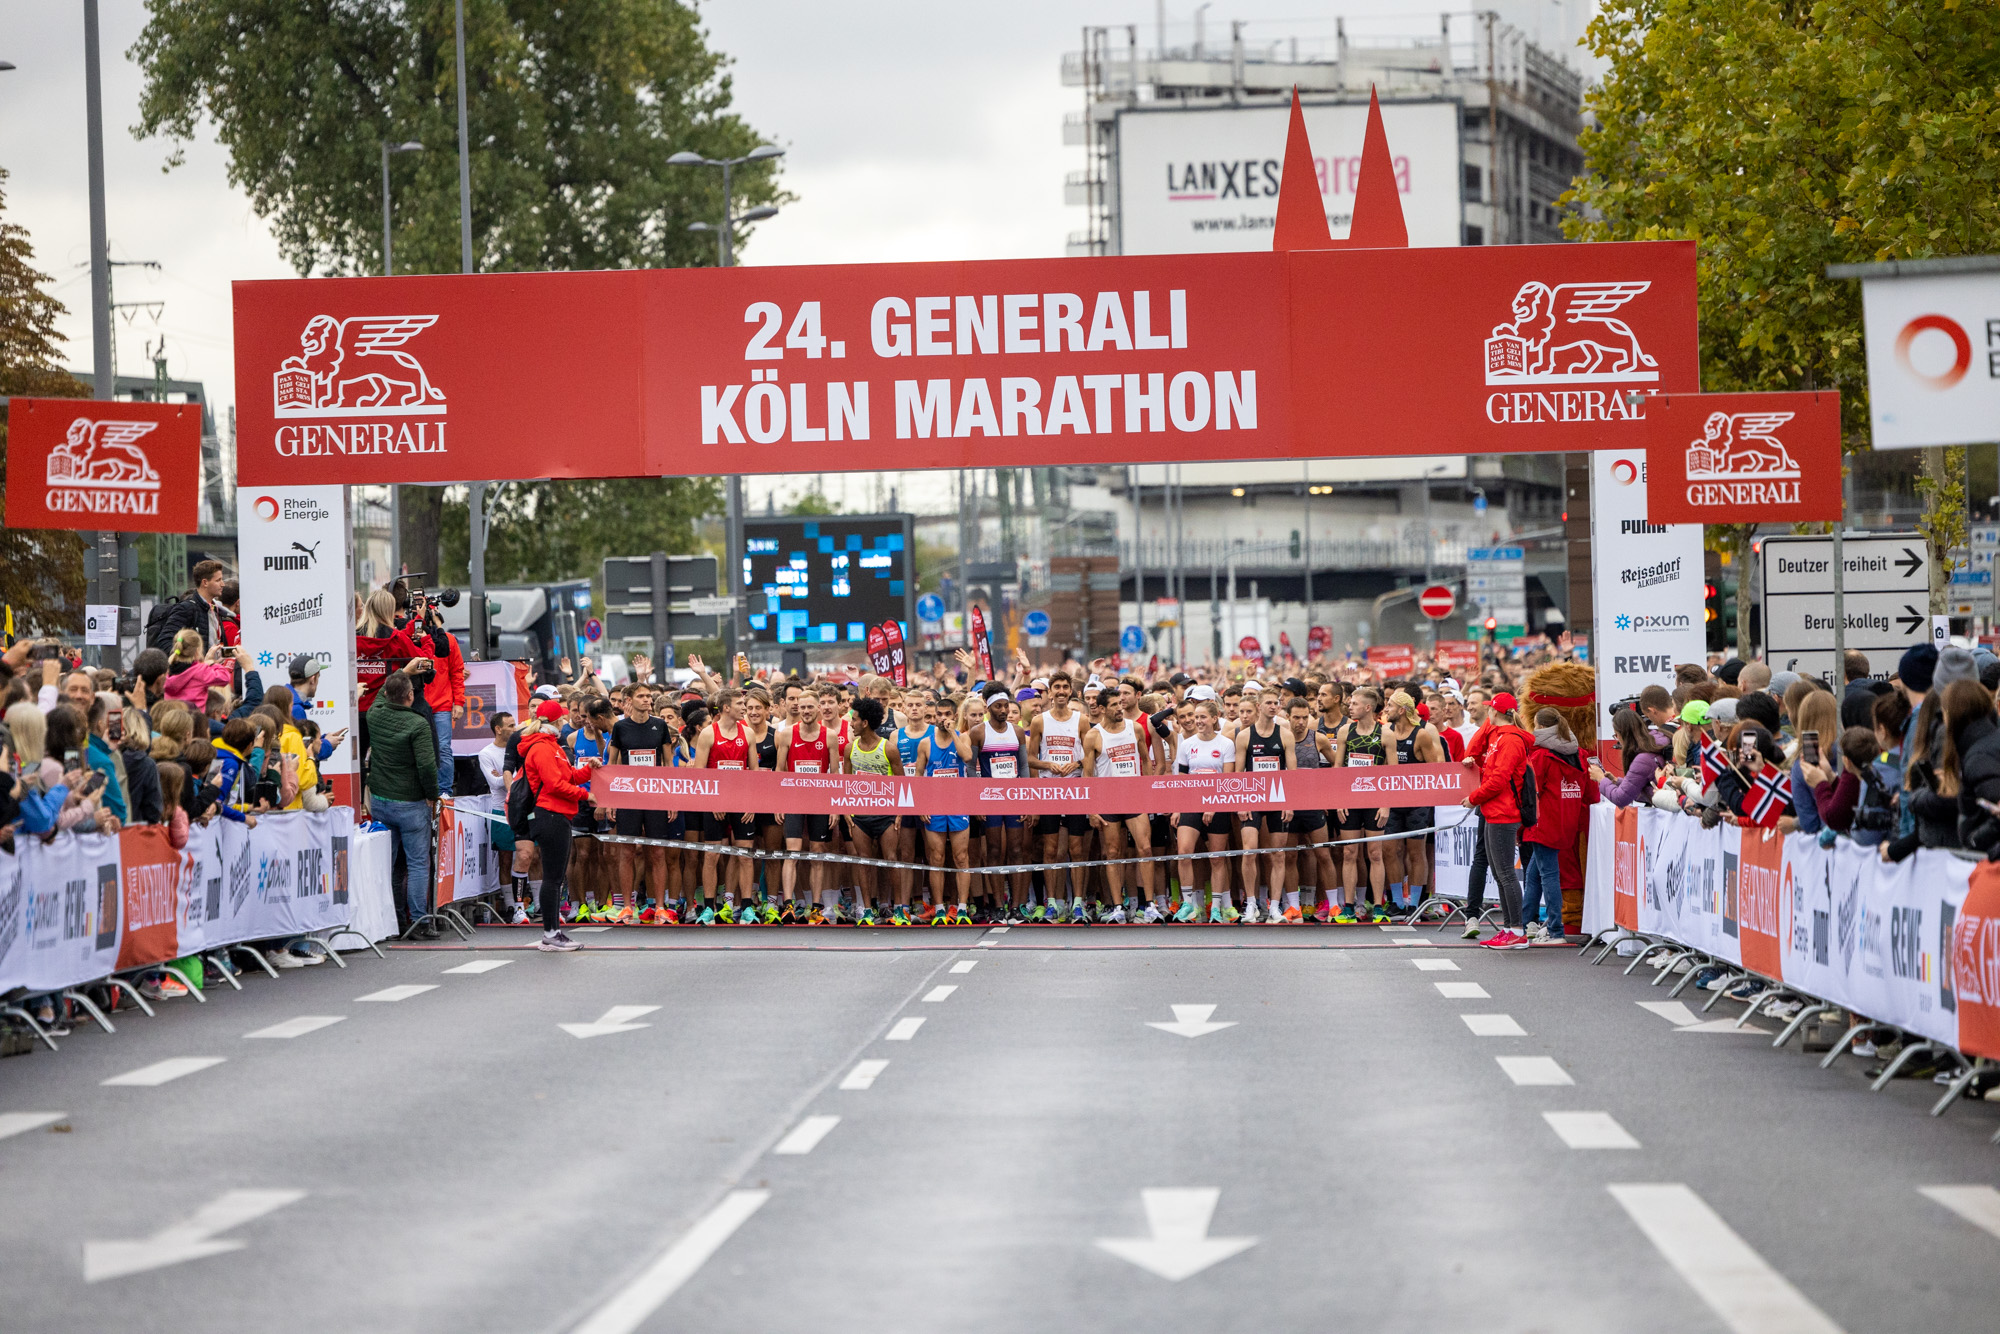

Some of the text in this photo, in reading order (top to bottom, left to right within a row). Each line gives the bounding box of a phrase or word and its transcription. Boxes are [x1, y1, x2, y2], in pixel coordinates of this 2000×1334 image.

[1167, 154, 1411, 199] LANXES area
[743, 288, 1188, 361] 24. GENERALI
[700, 368, 1258, 445] KÖLN MARATHON
[1486, 389, 1659, 424] GENERAL
[274, 422, 448, 457] GENERALI
[45, 488, 161, 515] GENERALI
[283, 498, 317, 508] Rhein
[1686, 480, 1801, 507] GENERALI
[284, 508, 329, 521] Energie
[264, 555, 309, 571] PUMA
[1620, 556, 1681, 584] Reissdorf
[1778, 555, 1888, 574] Deutzer reiheit
[1637, 571, 1680, 589] ALKOHOLFREI
[263, 593, 324, 621] Reissdorf
[279, 608, 323, 626] ALKOHOLFREI
[1633, 615, 1689, 633] pixum
[1805, 613, 1889, 632] Beruskolleg
[874, 654, 890, 675] 1:30
[891, 648, 903, 667] 30
[1614, 655, 1672, 673] REWE
[1352, 759, 1369, 767] 10004
[635, 777, 720, 796] GENERALI
[795, 778, 843, 789] GENERALI
[1166, 779, 1215, 789] GENERALI
[1377, 773, 1462, 792] GENERALI
[831, 797, 895, 807] MARATHON
[1006, 786, 1090, 801] GENERALI
[1202, 793, 1266, 805] MARATHON
[1561, 791, 1581, 799] ENERALI
[297, 848, 323, 898] REWE
[1891, 905, 1922, 981] REWE
